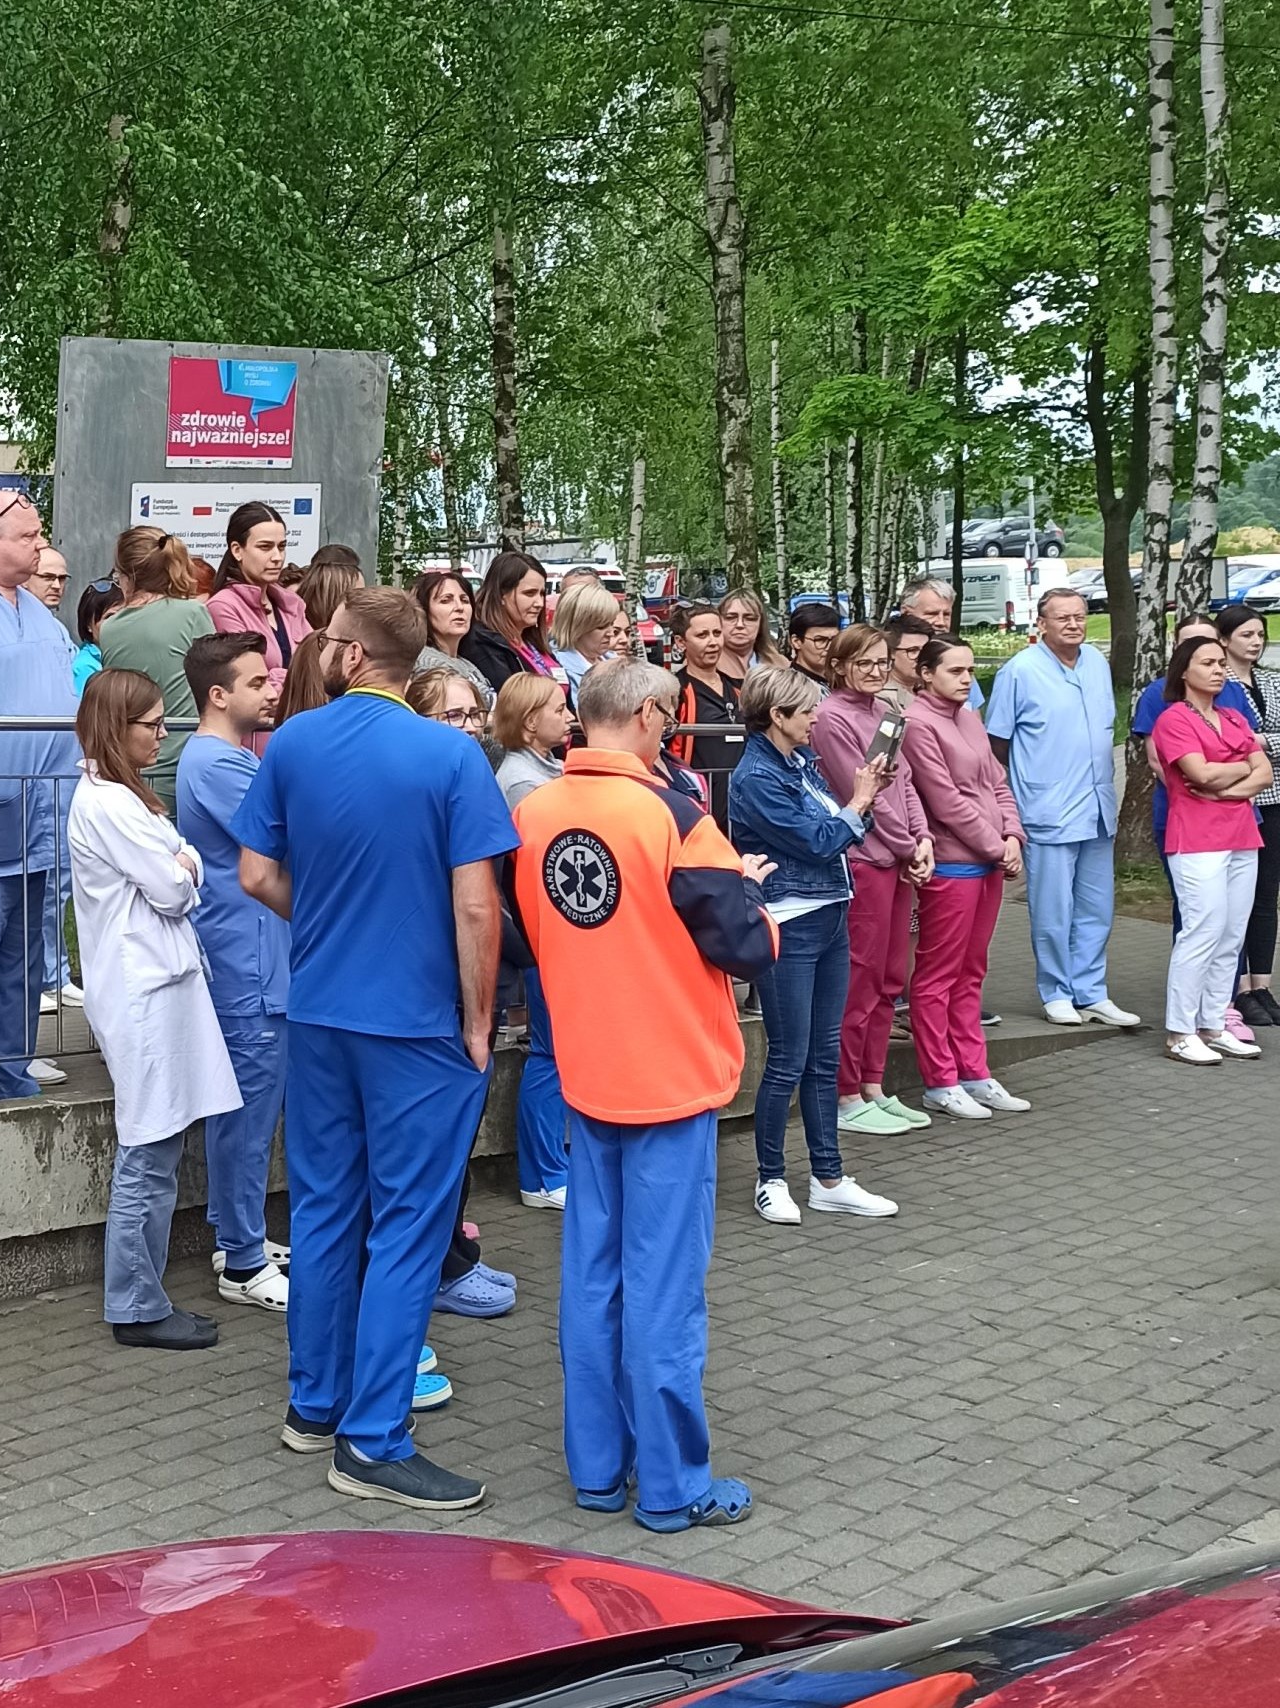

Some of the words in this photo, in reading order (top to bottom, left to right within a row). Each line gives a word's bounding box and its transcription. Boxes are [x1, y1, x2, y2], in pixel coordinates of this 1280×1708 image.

[181, 410, 246, 427] zdrowie
[171, 428, 291, 448] najważniejsze!
[545, 835, 575, 899] PAŃSTWOWE
[577, 834, 617, 905] RATOWNICTWO
[559, 902, 608, 924] MEDYCZNE
